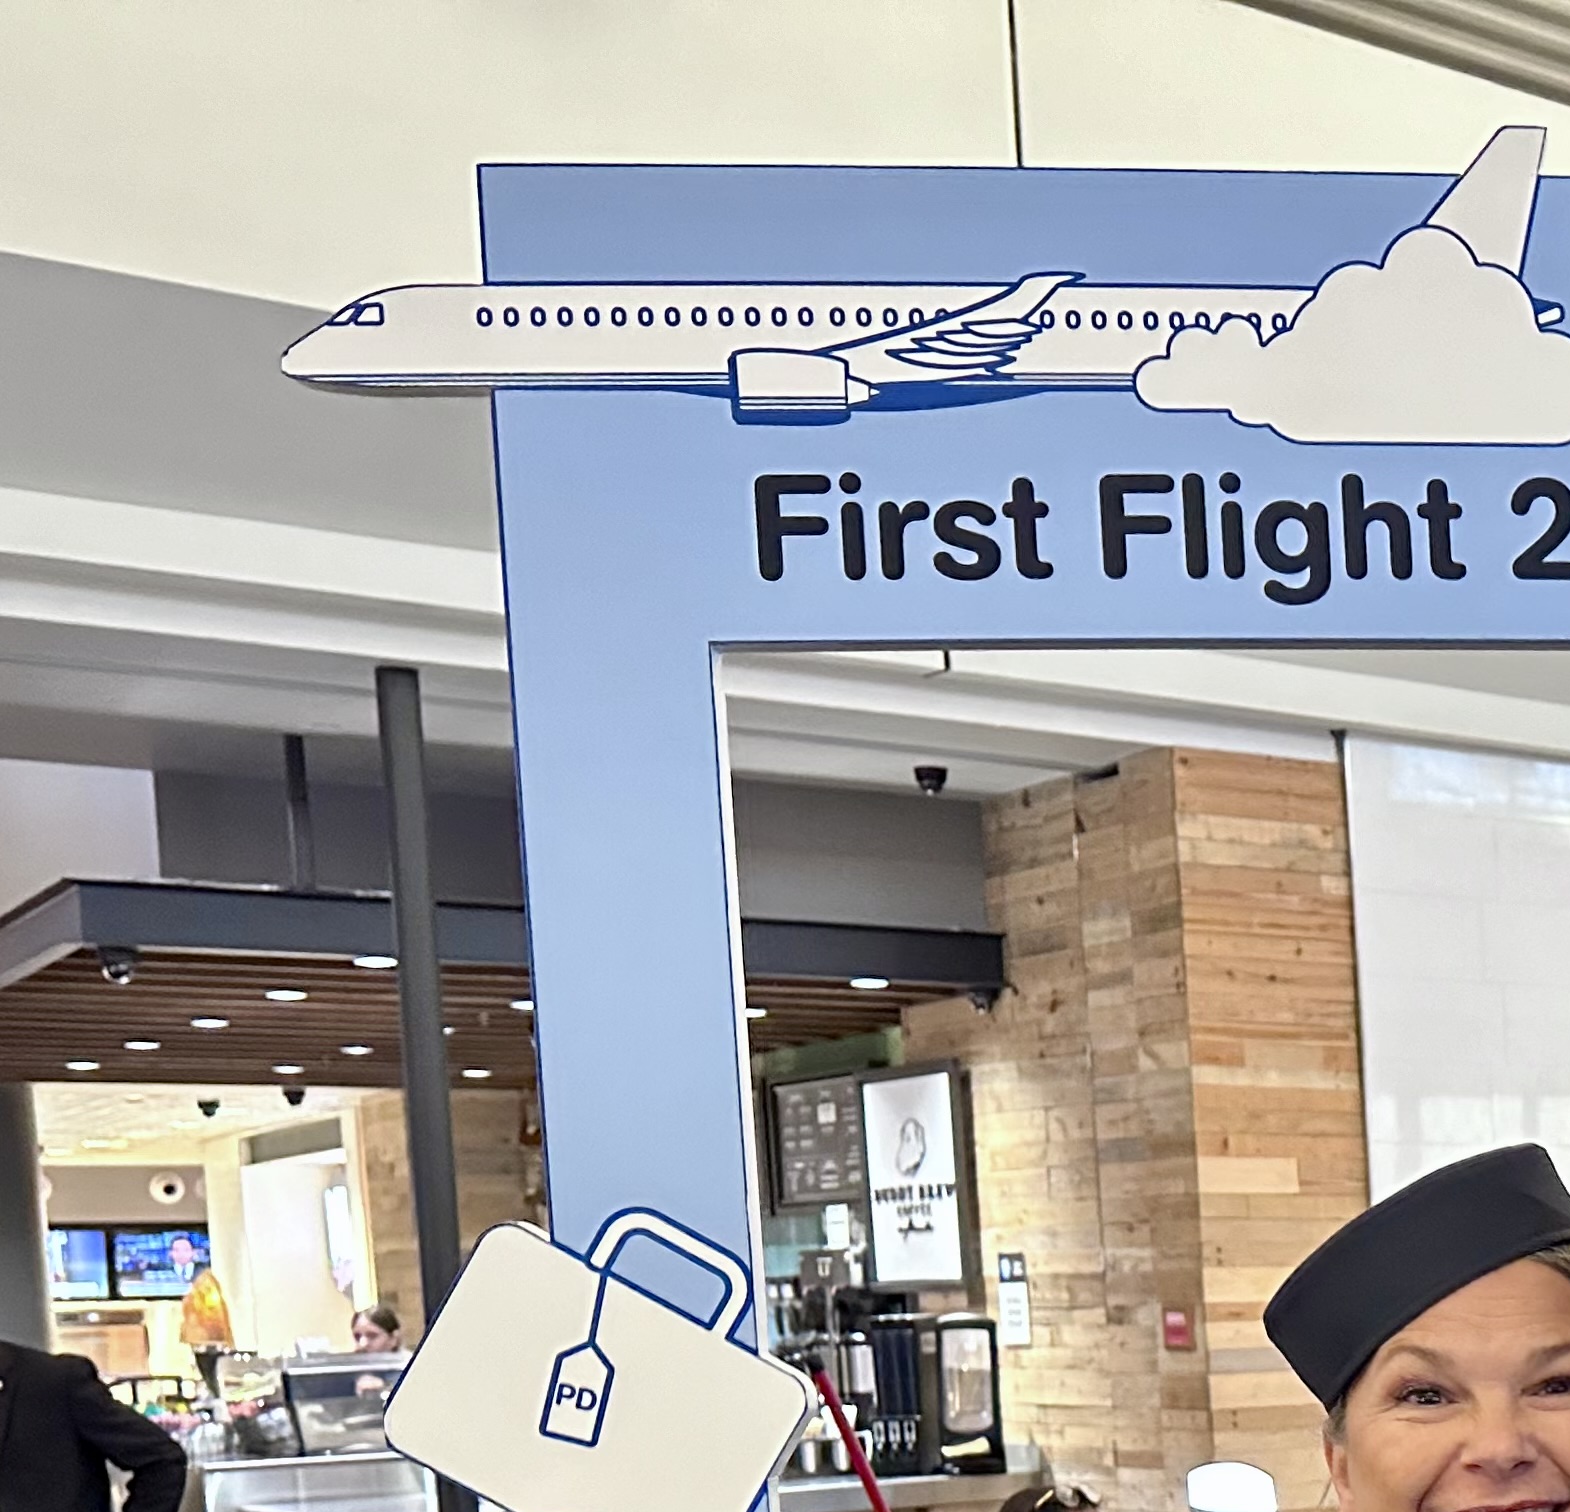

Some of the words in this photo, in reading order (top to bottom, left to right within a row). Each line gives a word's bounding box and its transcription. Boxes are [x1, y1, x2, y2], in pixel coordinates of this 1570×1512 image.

[754, 472, 1055, 583] First
[1099, 472, 1467, 606] Flight
[556, 1383, 597, 1411] PD
